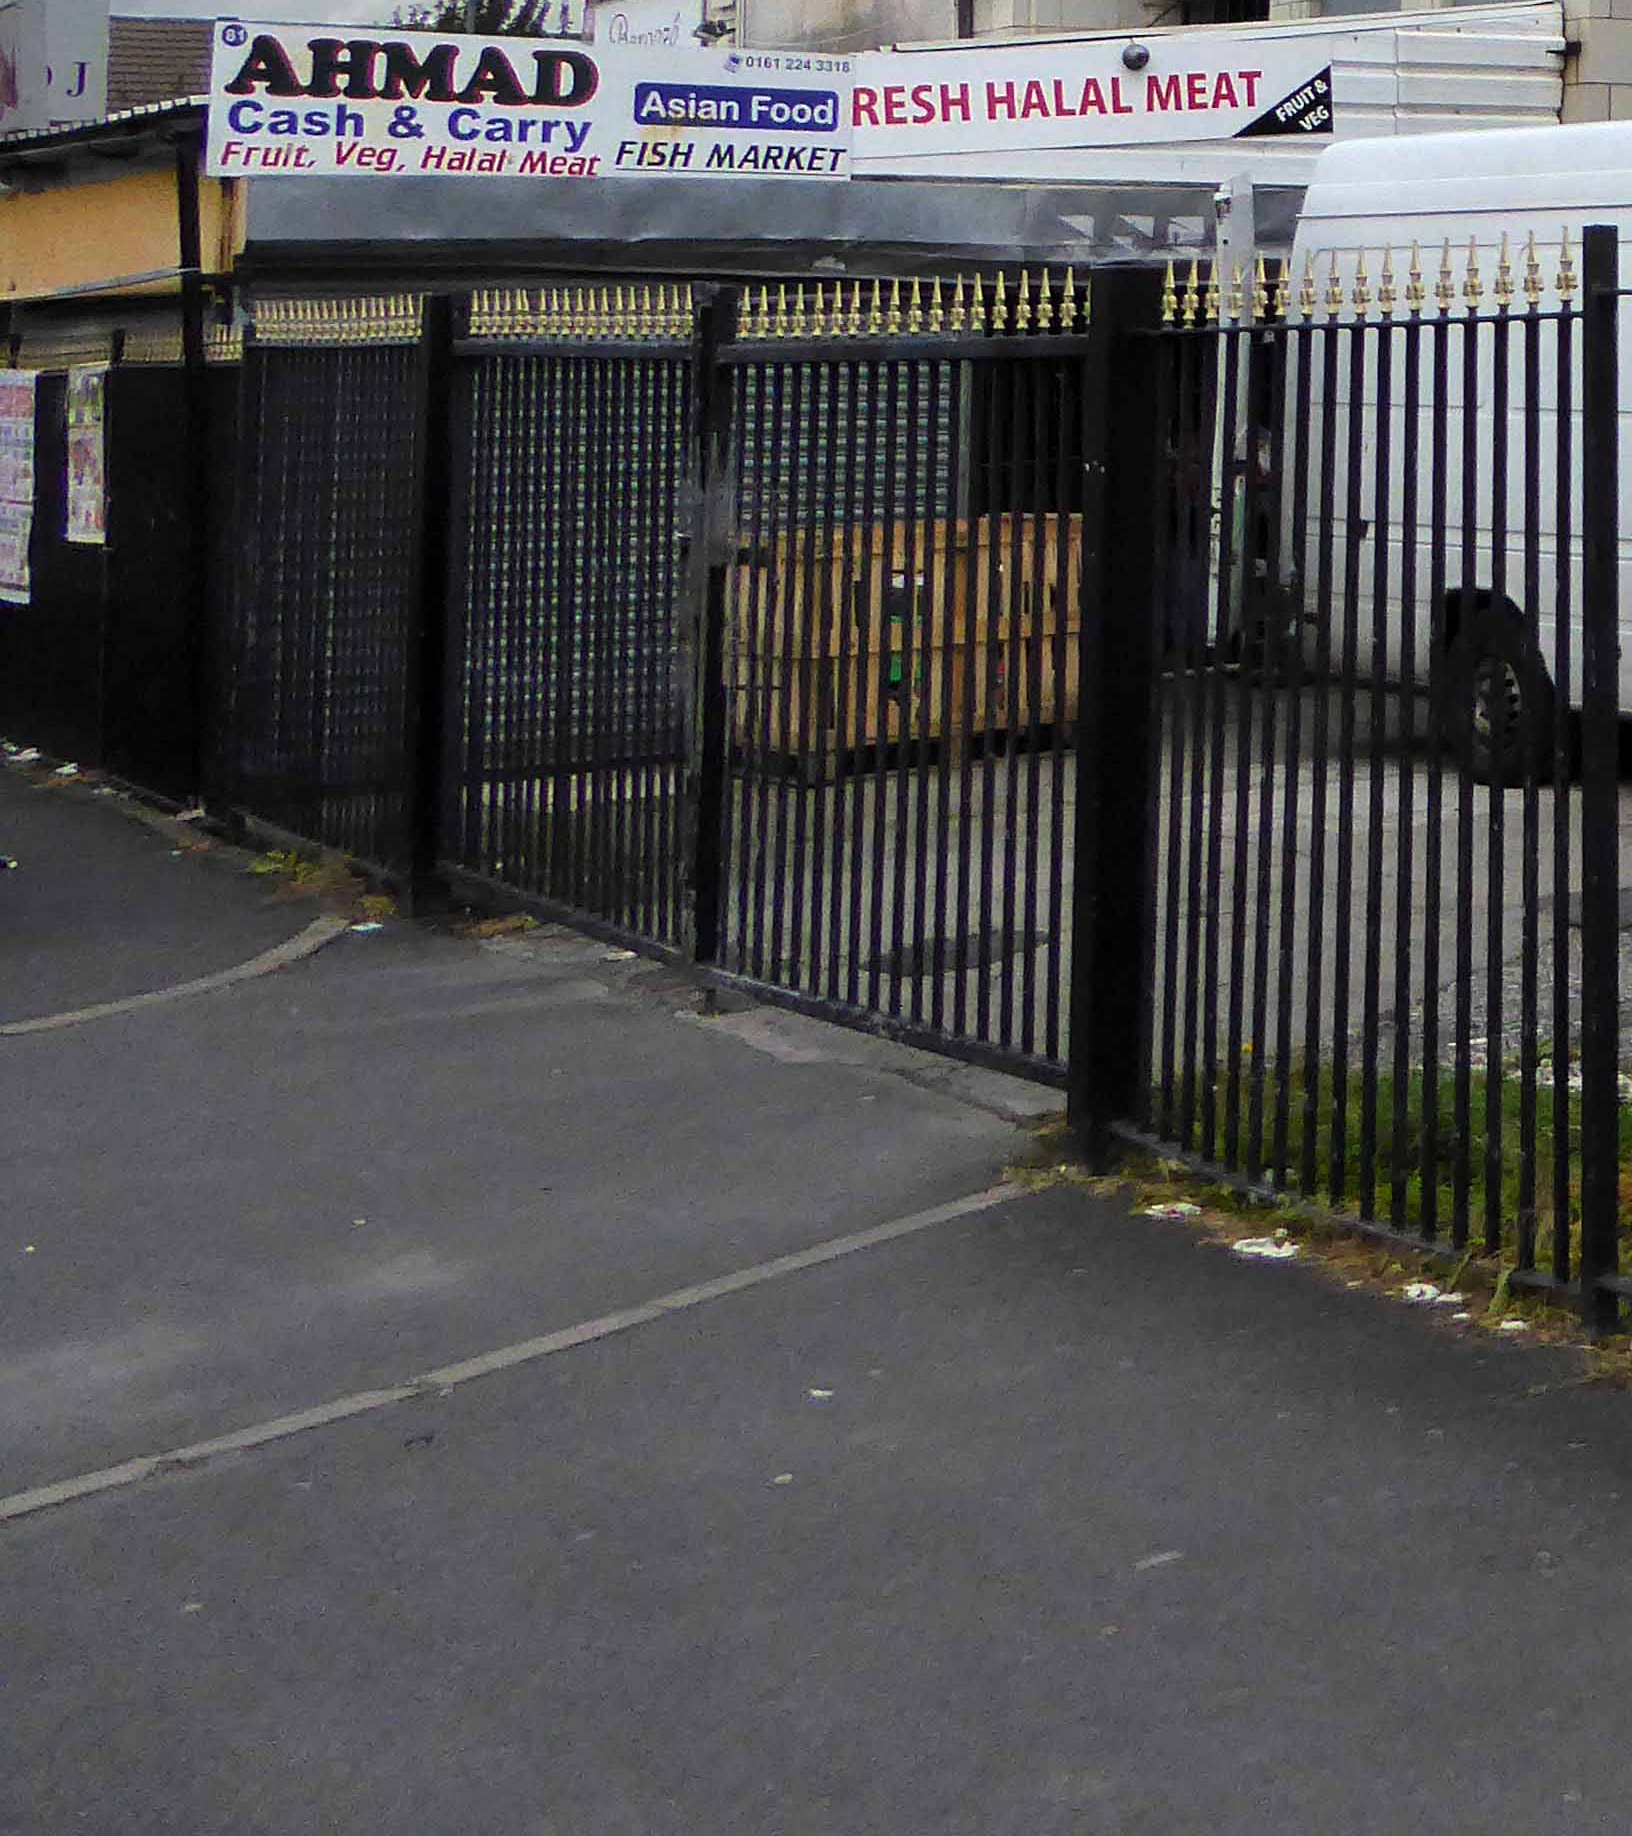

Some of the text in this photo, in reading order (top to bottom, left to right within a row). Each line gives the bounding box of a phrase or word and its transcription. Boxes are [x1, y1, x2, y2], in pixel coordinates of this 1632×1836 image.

[225, 29, 246, 44] 81
[224, 33, 600, 107] AHMAD
[746, 55, 780, 70] 0161
[785, 57, 812, 71] 224
[640, 90, 834, 125] Asian Food
[986, 75, 1133, 121] HALAL
[1146, 70, 1263, 113] MEAT
[1275, 79, 1329, 123] FRUIT &
[227, 99, 593, 153] Cash & Carry
[1298, 105, 1330, 131] VEG
[219, 140, 601, 177] Fruit, Veg, Halal Meat
[615, 140, 848, 172] FISH MARKET
